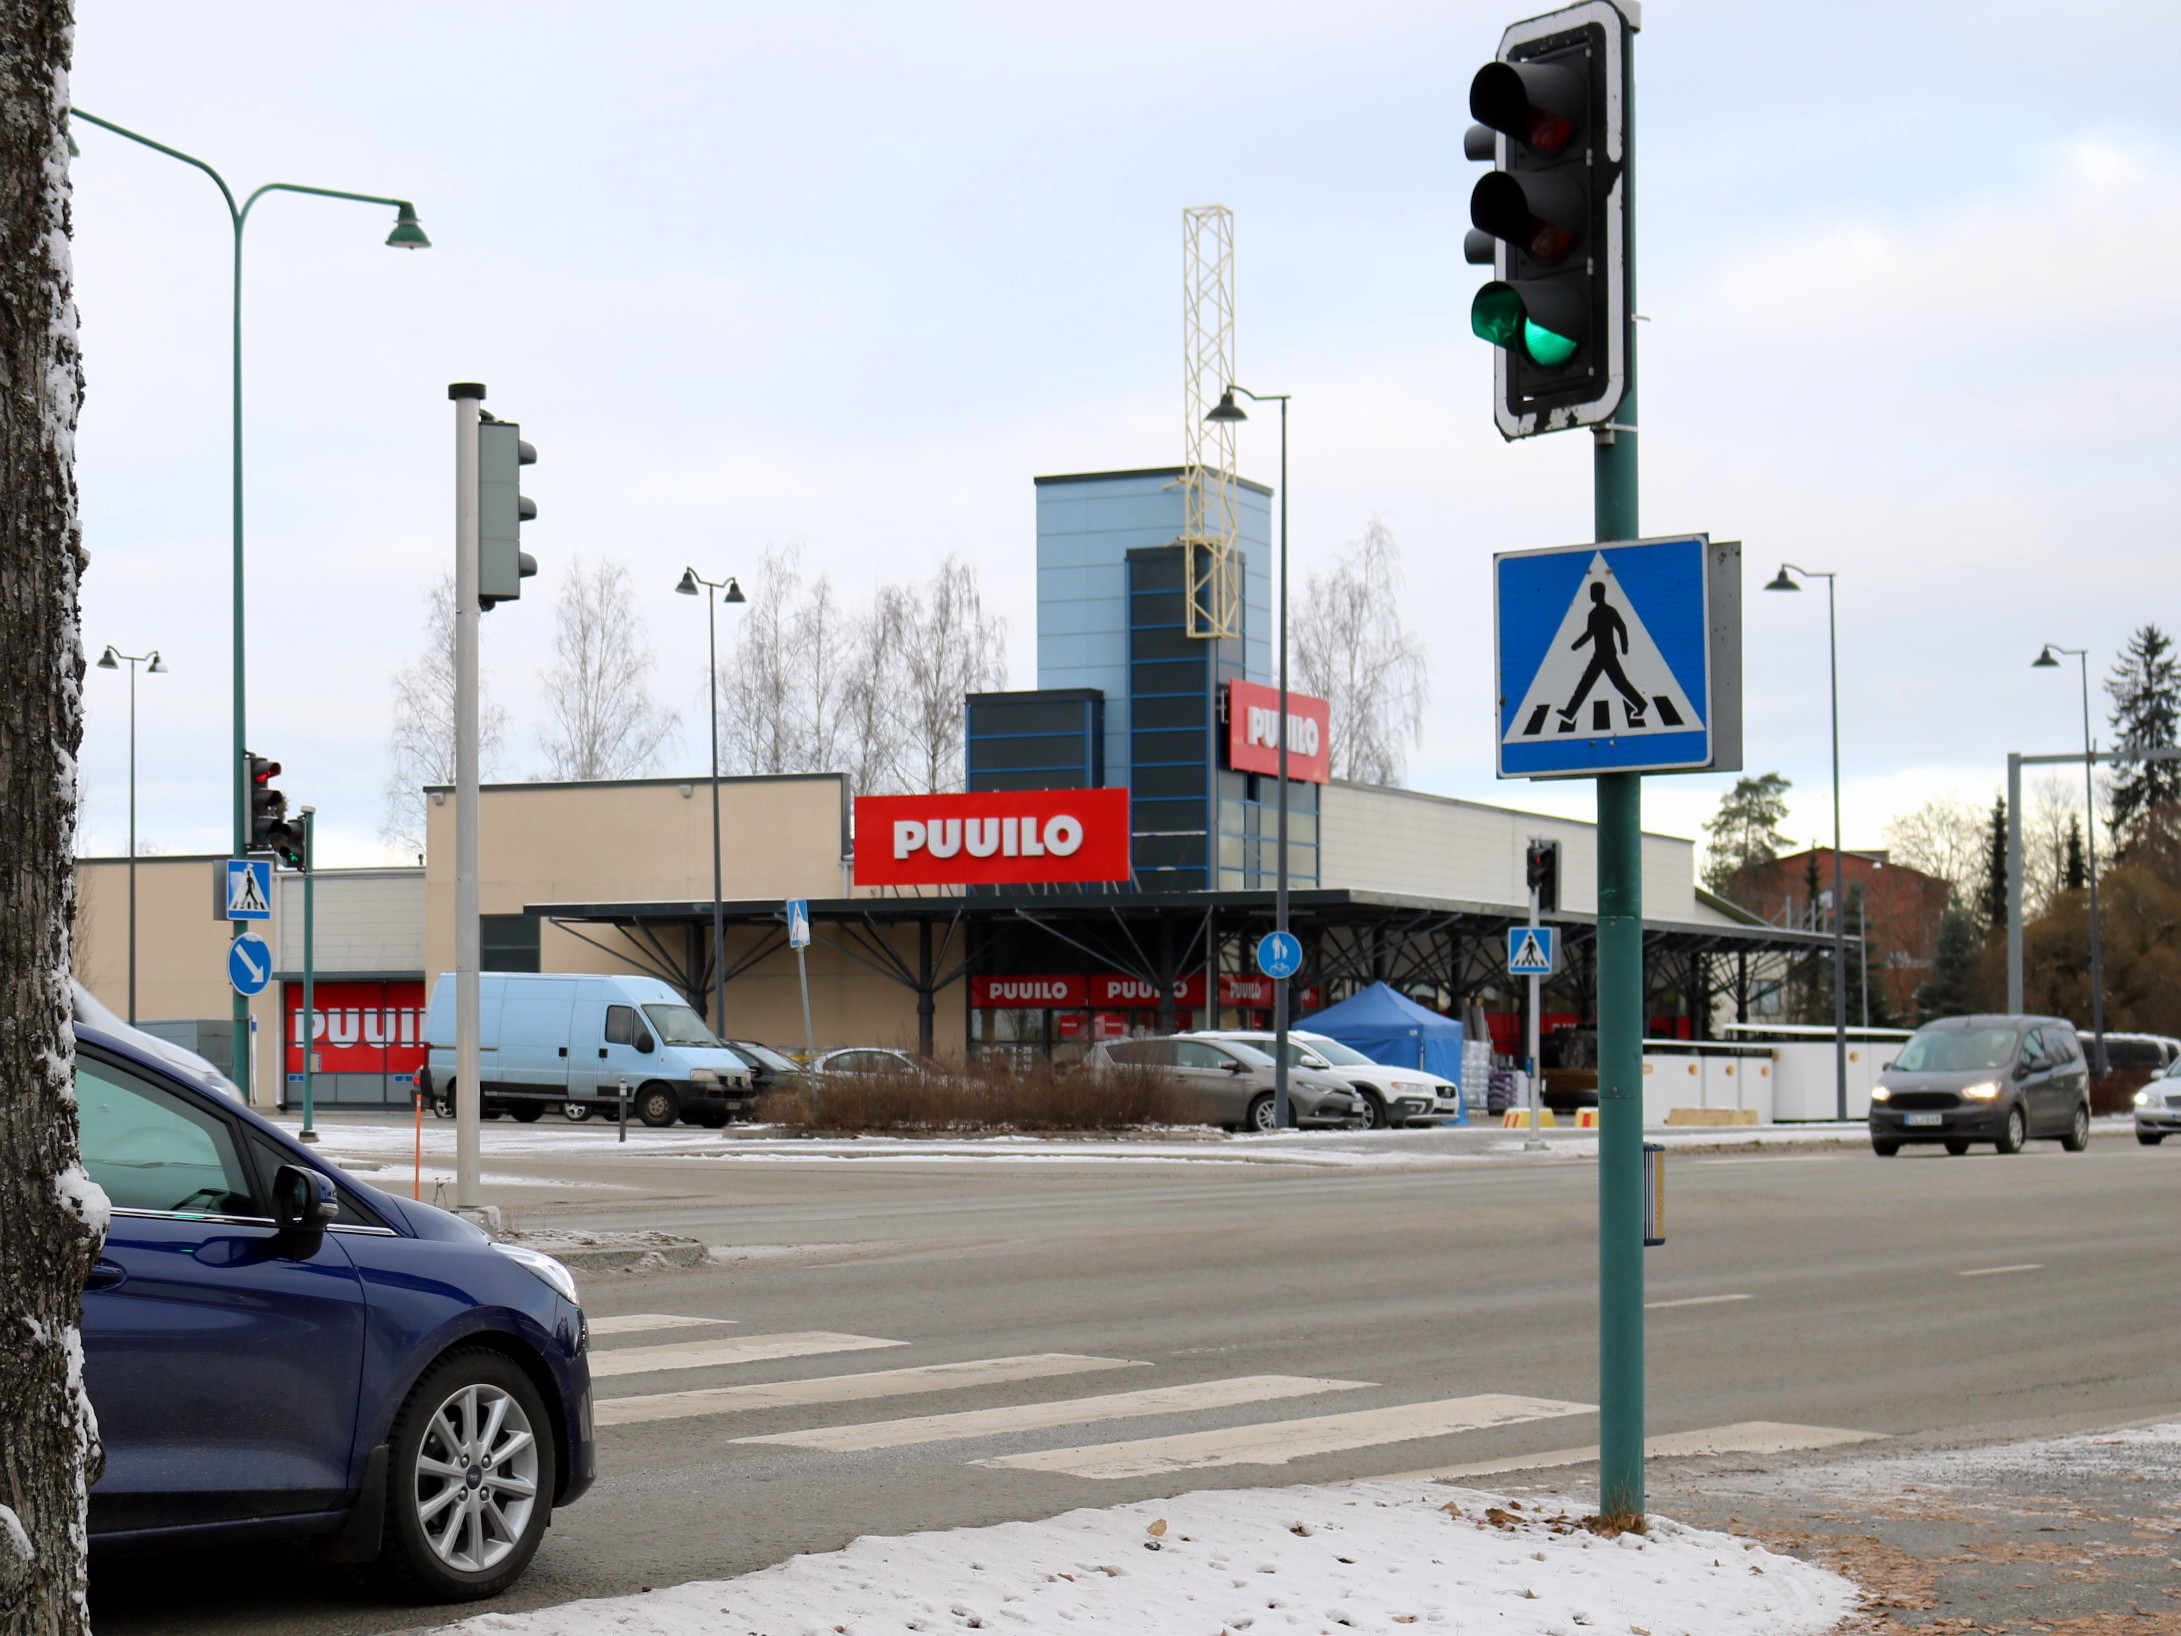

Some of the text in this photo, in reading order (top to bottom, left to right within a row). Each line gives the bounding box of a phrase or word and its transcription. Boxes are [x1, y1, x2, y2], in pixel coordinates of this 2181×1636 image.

[1247, 705, 1320, 757] PUILO
[893, 814, 1084, 859] PUUILO
[989, 981, 1068, 999] PUUILO
[1230, 981, 1262, 1000] PUUILO
